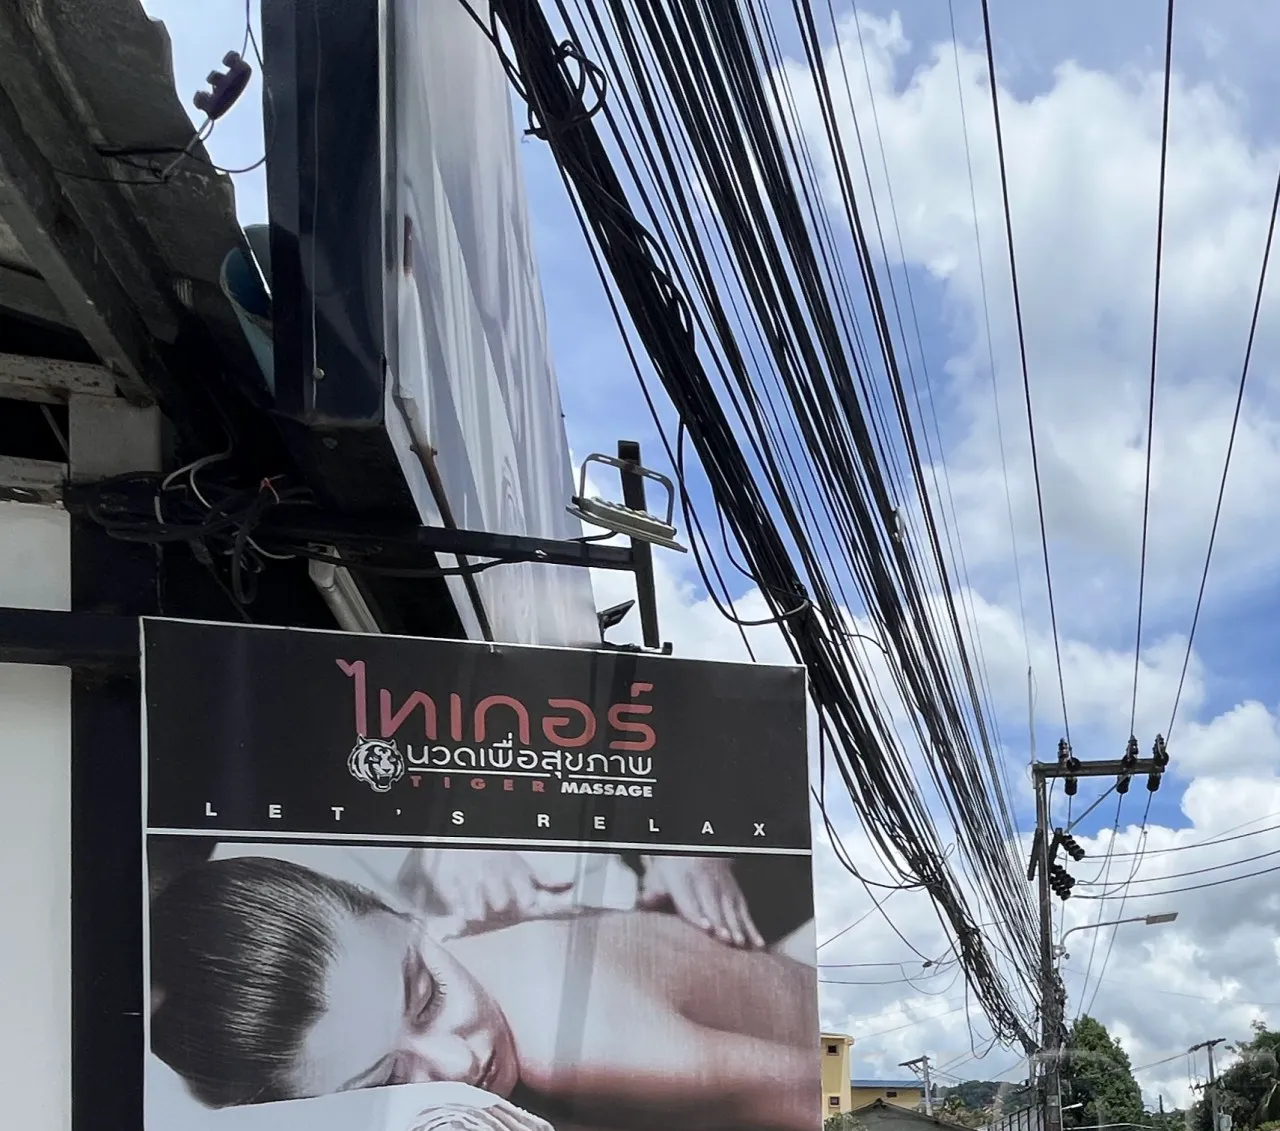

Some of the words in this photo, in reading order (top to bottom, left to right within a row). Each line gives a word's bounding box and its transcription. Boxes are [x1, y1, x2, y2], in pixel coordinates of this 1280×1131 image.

[336, 659, 656, 750] ไทเกอร์
[407, 733, 652, 779] นวดเพื่อสุขภาพ
[410, 776, 545, 793] TIGER
[561, 781, 652, 798] MASSAGE
[537, 814, 766, 836] RELAX
